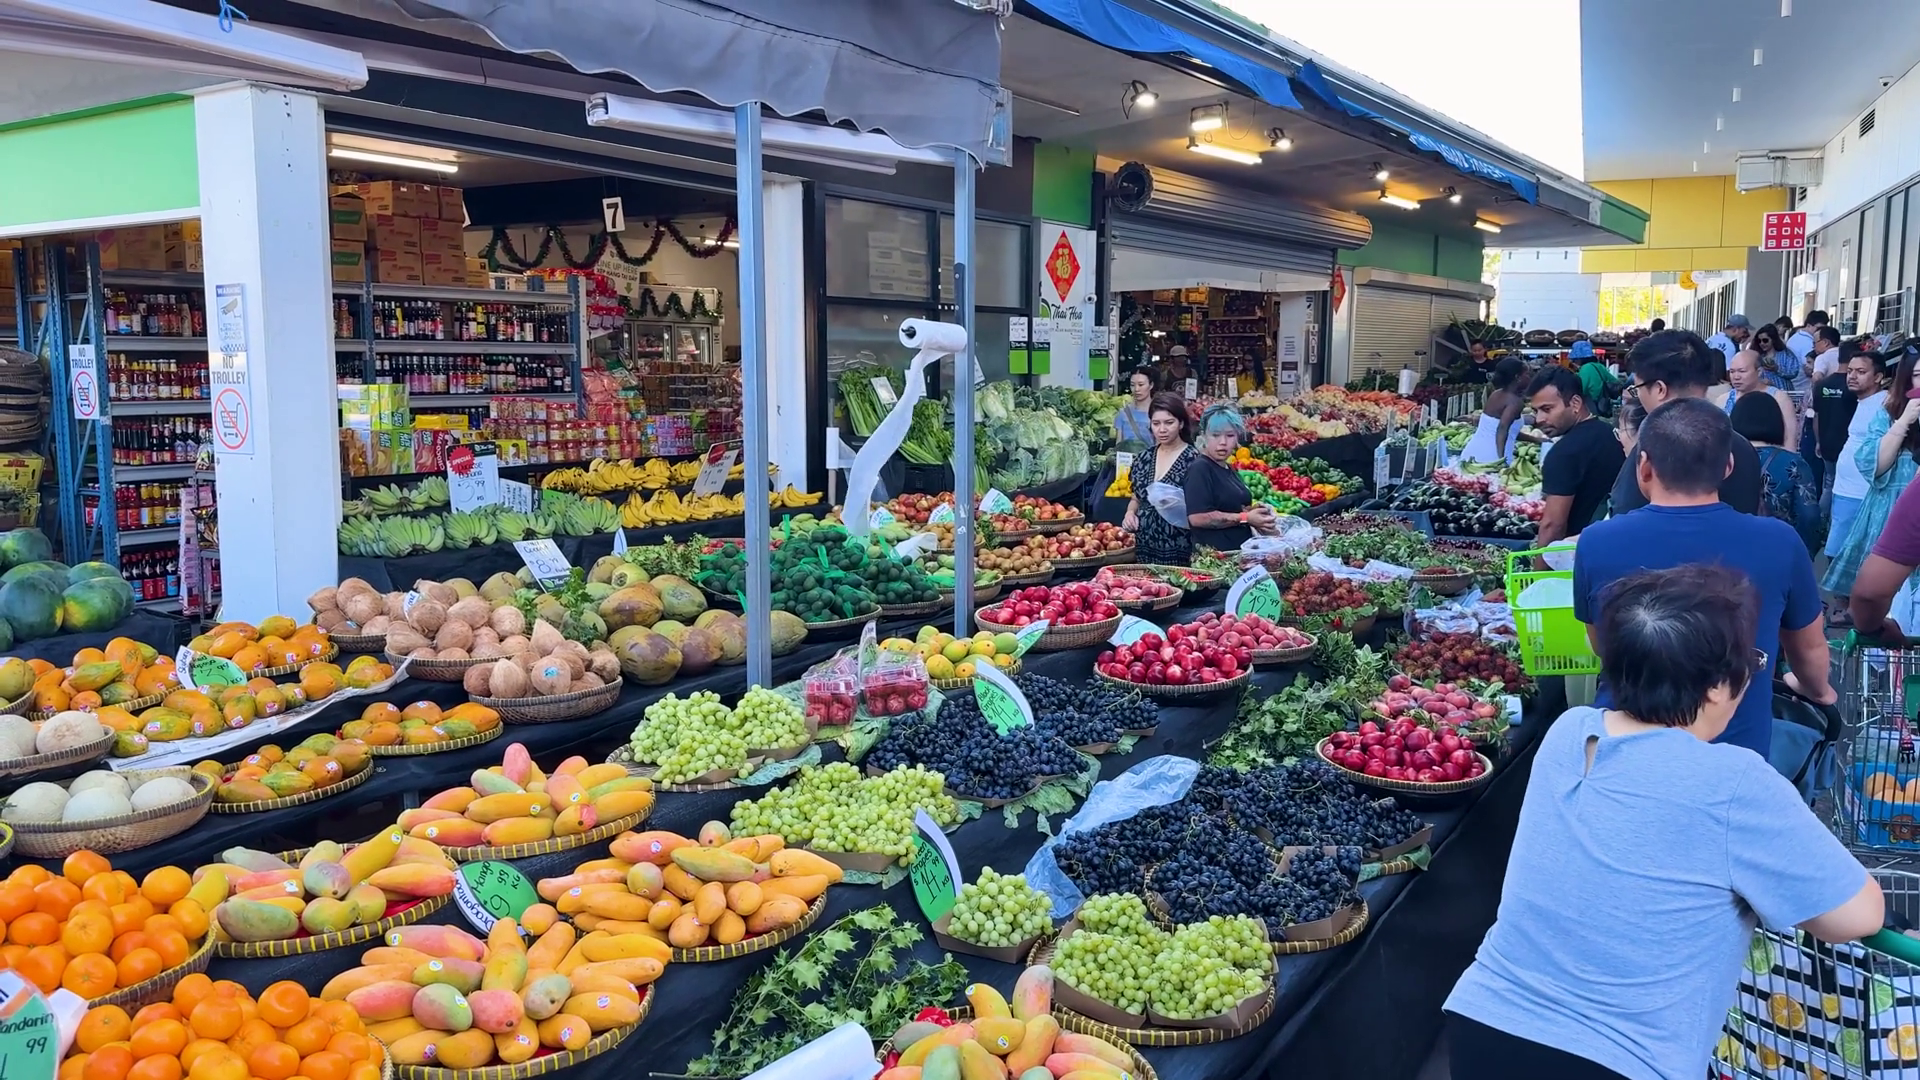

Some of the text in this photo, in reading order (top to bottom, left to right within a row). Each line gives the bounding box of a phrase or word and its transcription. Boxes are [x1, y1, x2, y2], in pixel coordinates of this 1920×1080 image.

[606, 202, 619, 229] 7
[1768, 215, 1800, 224] SAI
[1768, 227, 1803, 236] GON
[1768, 239, 1802, 248] BBQ
[613, 262, 621, 271] UP
[623, 265, 638, 275] HERE
[1068, 305, 1083, 321] Hoa
[78, 347, 86, 357] NO
[72, 358, 94, 369] TROLLEY
[222, 356, 234, 369] NO
[212, 371, 246, 384] TROLLEY
[452, 455, 472, 465] SPECIAL
[1269, 598, 1280, 608] 99
[216, 661, 230, 671] 99
[914, 842, 927, 859] reen
[911, 849, 933, 875] Grapes
[931, 856, 940, 867] 99
[471, 860, 494, 894] Mango
[496, 869, 510, 886] 99
[511, 874, 521, 890] KG
[941, 874, 950, 887] KG
[0, 1013, 55, 1034] andarin
[26, 1036, 48, 1054] 99
